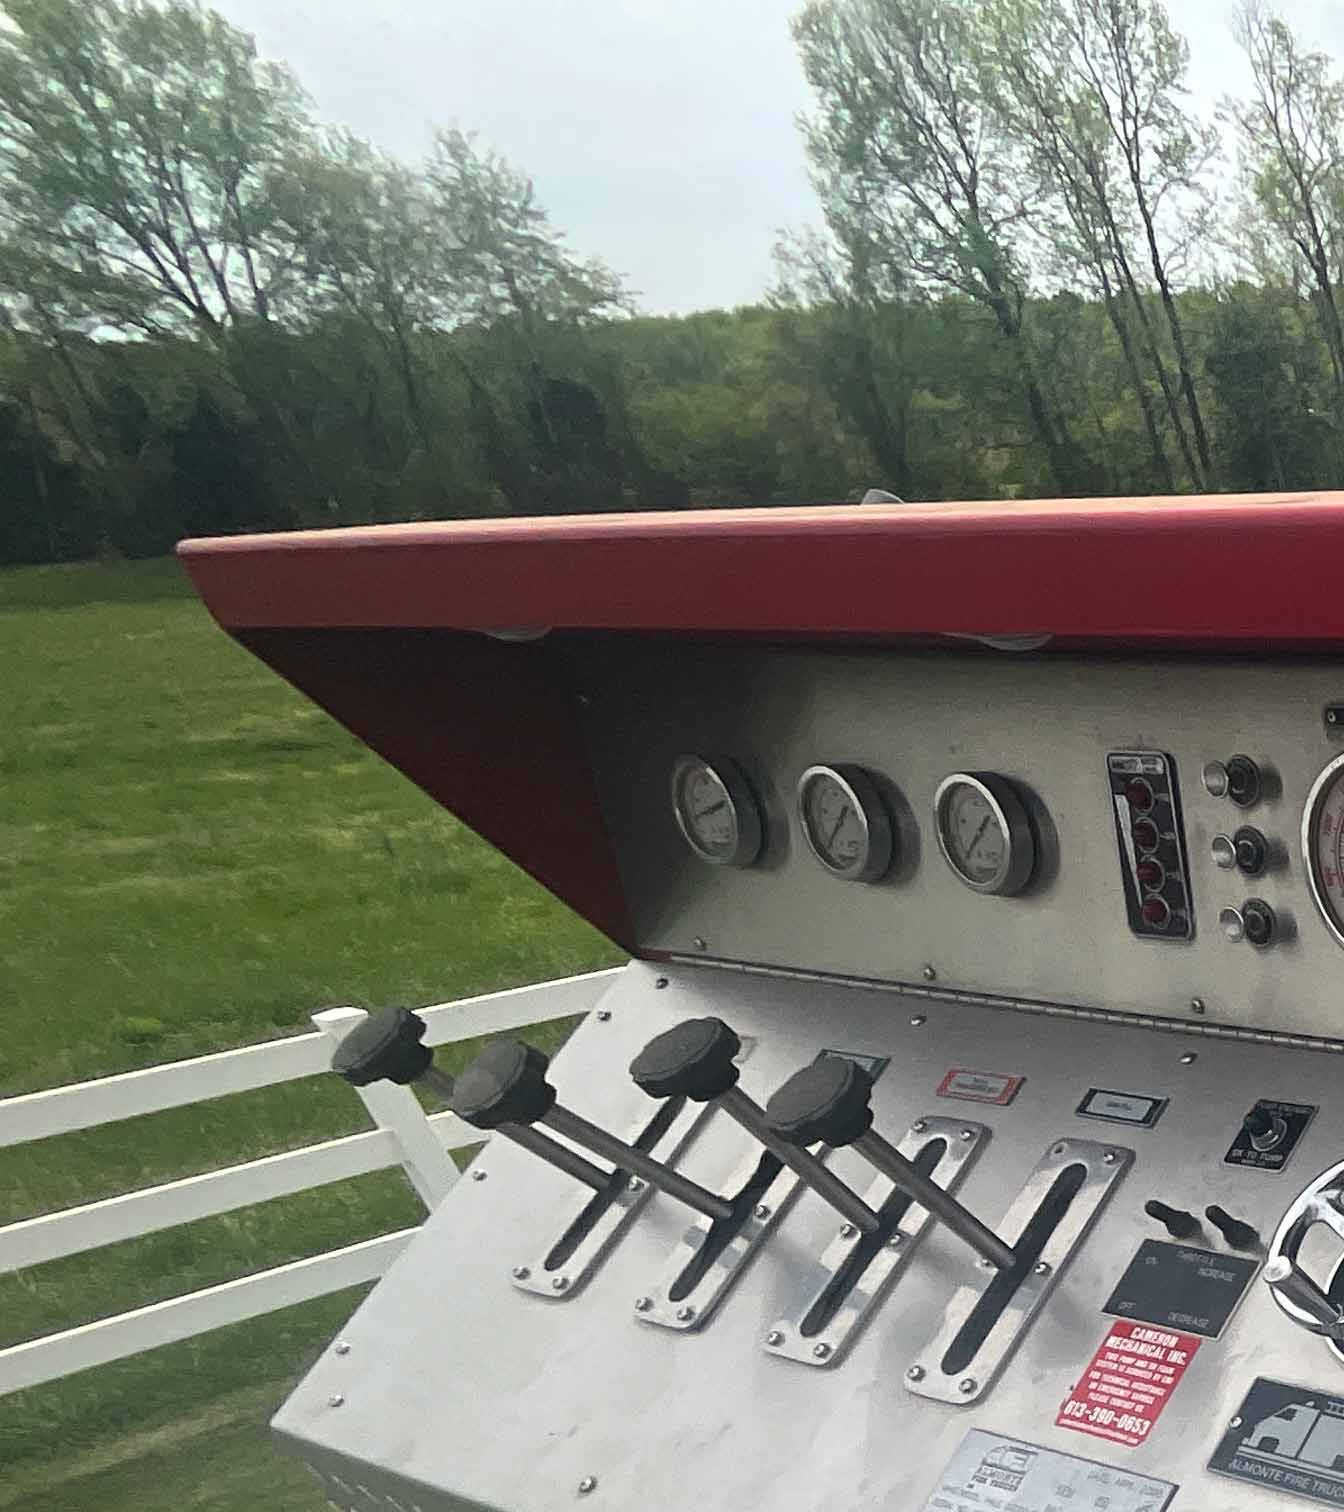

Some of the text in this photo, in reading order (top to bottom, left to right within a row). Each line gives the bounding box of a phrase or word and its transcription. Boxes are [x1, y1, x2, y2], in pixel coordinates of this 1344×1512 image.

[1105, 1335, 1187, 1366] MECHANICAL INC.
[1130, 1326, 1179, 1348] CAMERON
[1063, 1400, 1152, 1436] 613-390-0653
[1229, 1458, 1283, 1483] ALMONTE
[1283, 1470, 1312, 1491] FIRE
